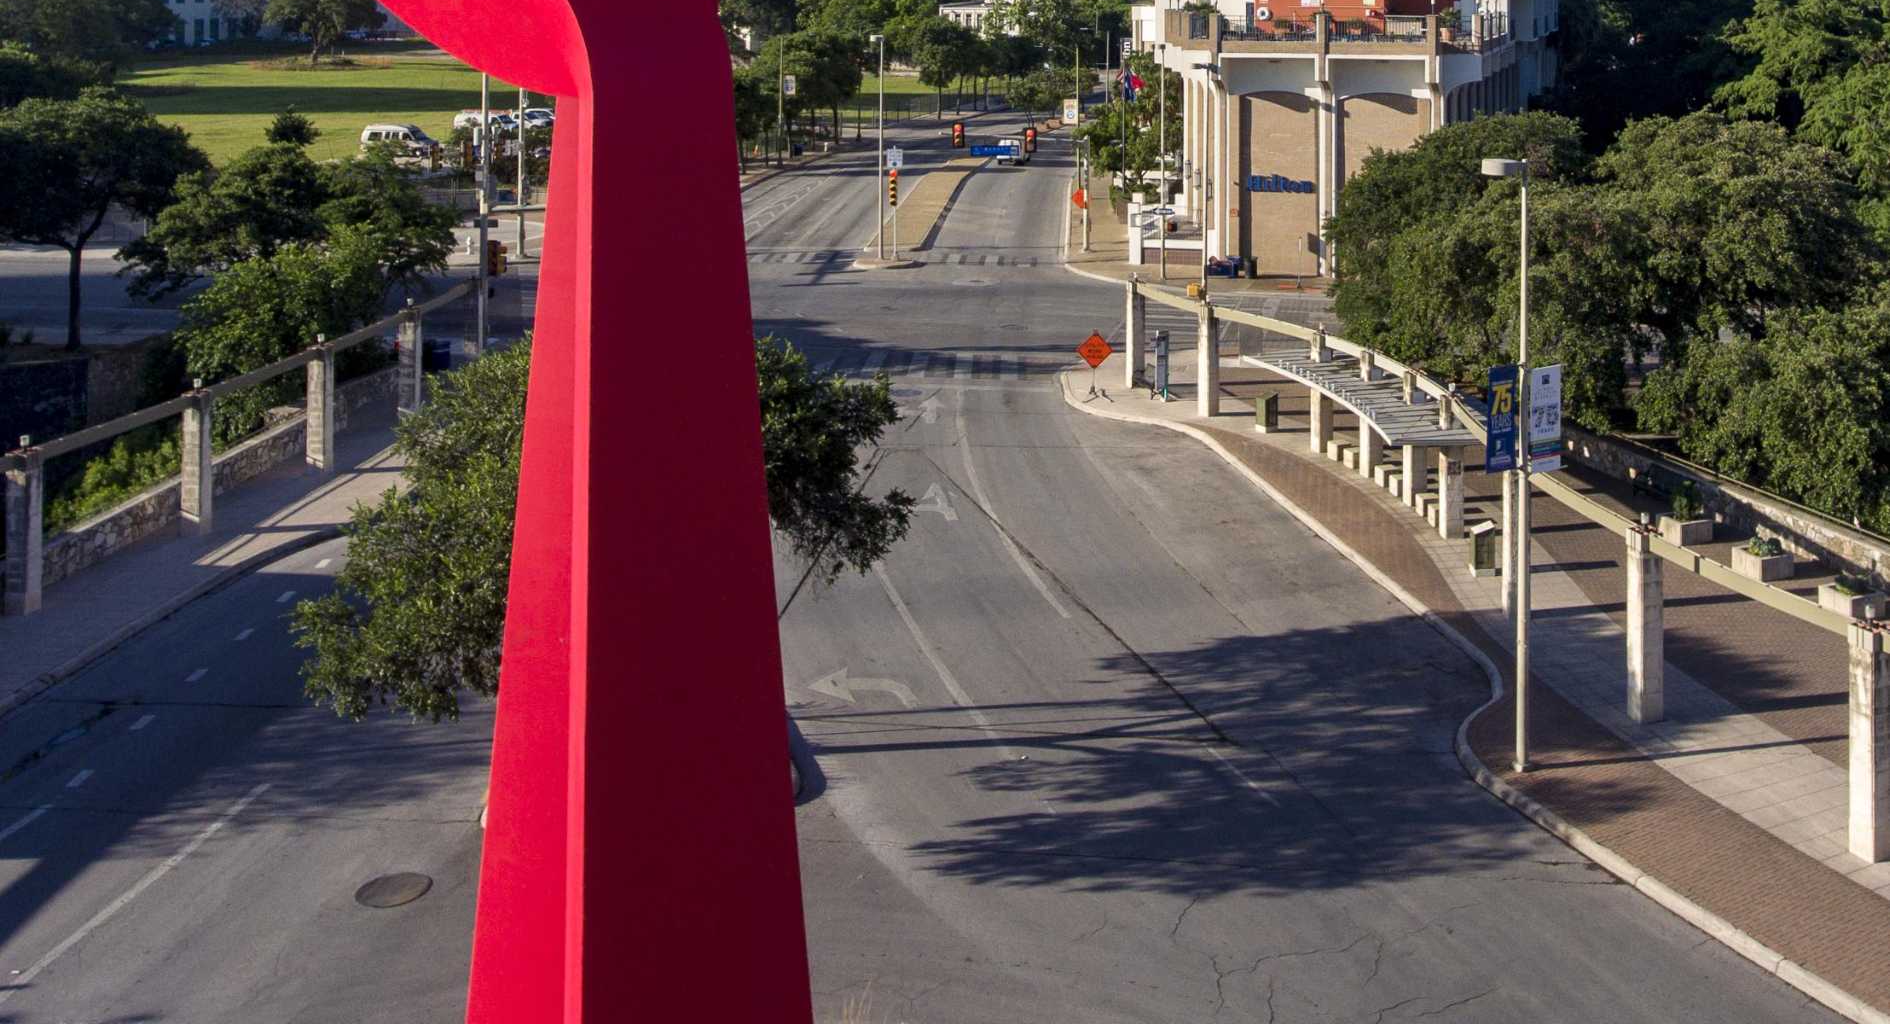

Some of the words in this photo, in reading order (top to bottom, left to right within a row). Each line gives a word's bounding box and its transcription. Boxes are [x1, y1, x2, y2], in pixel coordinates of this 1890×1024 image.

[1247, 174, 1313, 193] Hilton
[1491, 383, 1512, 416] 75
[1491, 415, 1512, 429] YEARS
